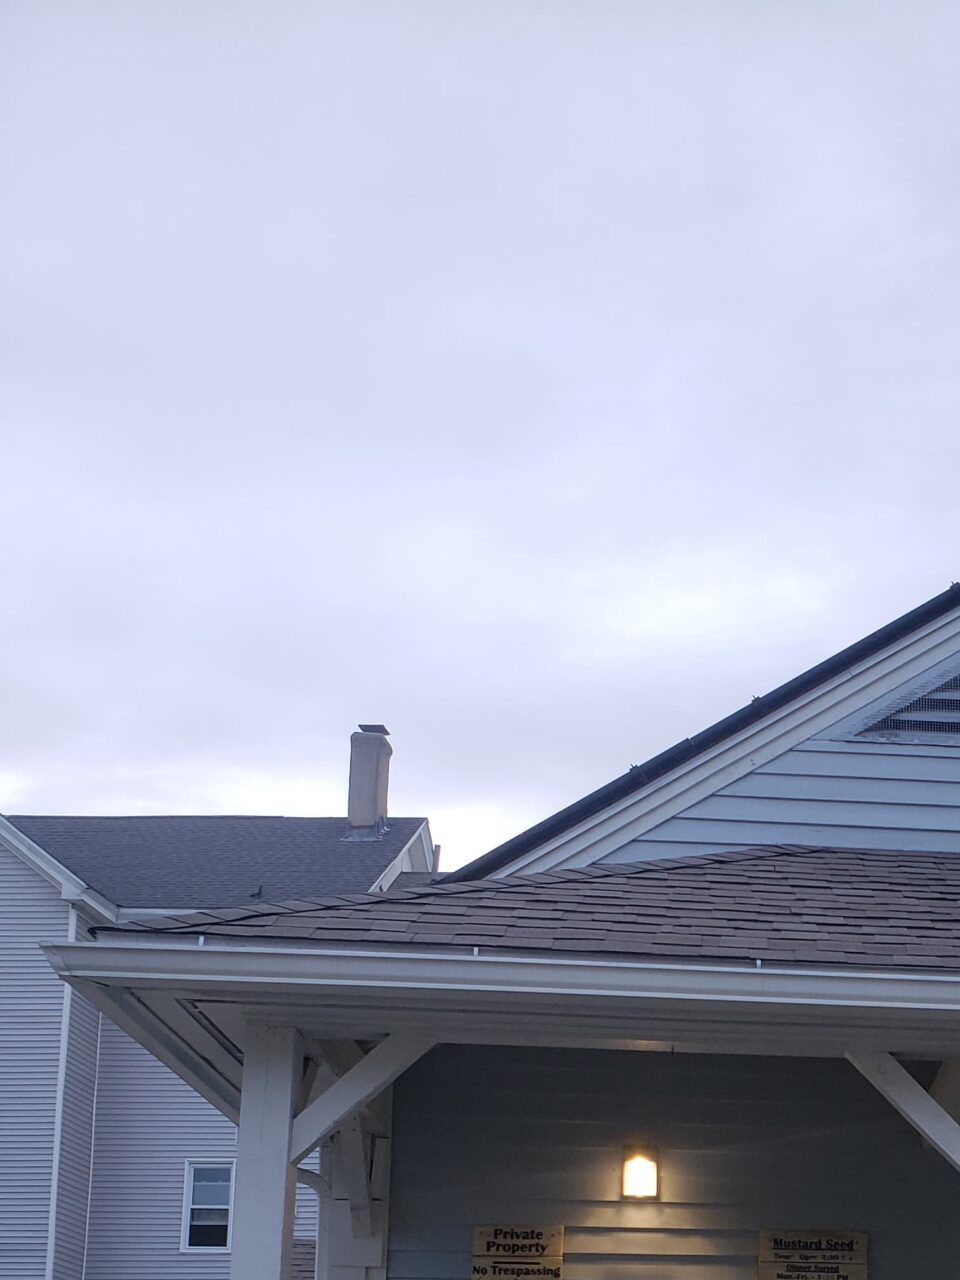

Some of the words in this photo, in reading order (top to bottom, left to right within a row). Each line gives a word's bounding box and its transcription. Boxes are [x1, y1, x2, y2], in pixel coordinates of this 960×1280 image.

[493, 1228, 544, 1240] Private
[486, 1241, 549, 1255] Property
[772, 1238, 822, 1250] Mustard
[825, 1239, 854, 1250] Seed
[472, 1265, 488, 1275] No
[490, 1265, 561, 1278] Trespassing
